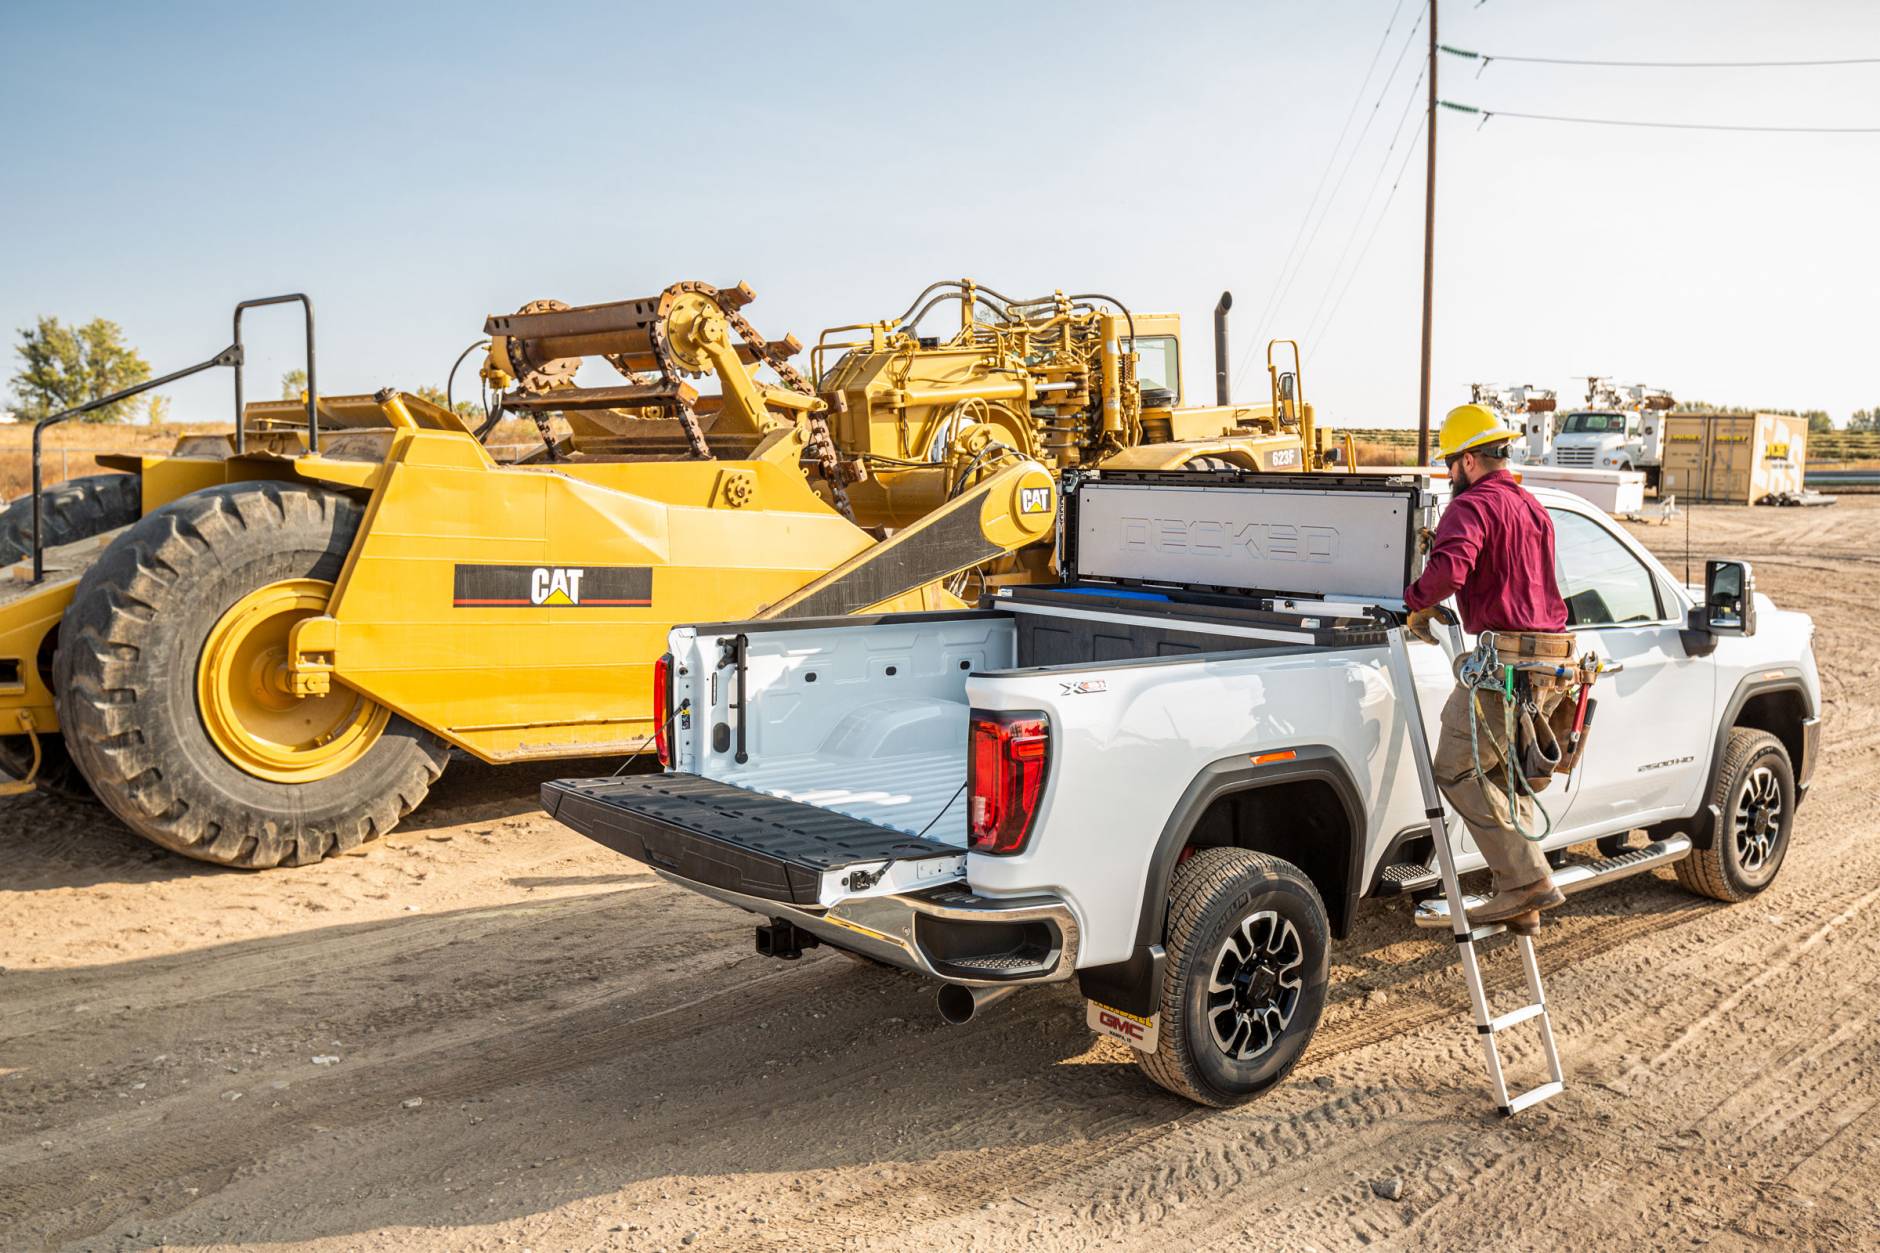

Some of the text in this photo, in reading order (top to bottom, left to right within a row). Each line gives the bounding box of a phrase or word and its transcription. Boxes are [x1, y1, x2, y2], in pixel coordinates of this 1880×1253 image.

[1272, 449, 1295, 467] 623F
[1022, 488, 1049, 513] CAT
[1120, 516, 1340, 564] DECKED
[531, 567, 584, 605] CAT
[1099, 1010, 1145, 1041] GMC
